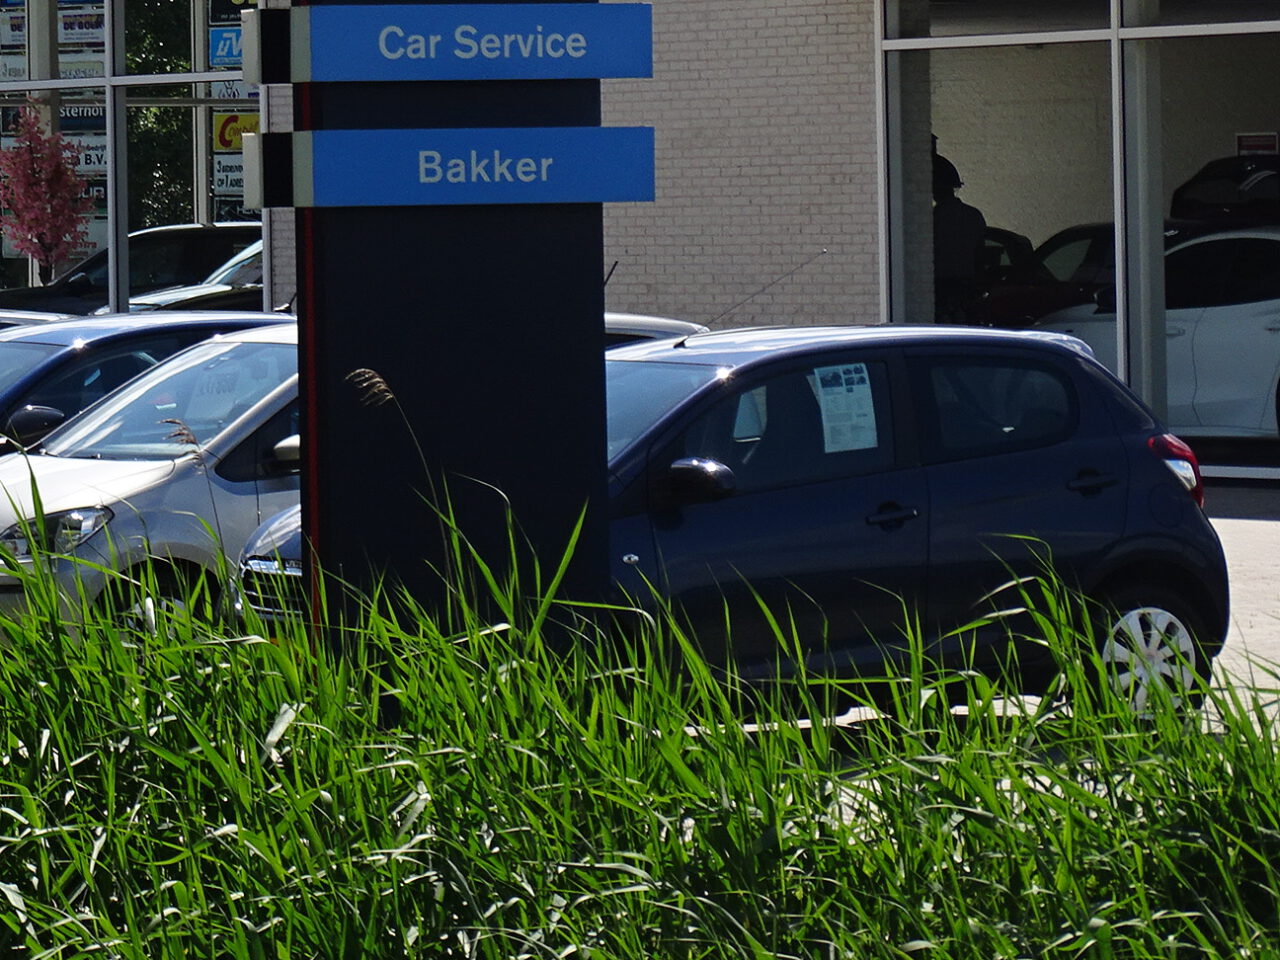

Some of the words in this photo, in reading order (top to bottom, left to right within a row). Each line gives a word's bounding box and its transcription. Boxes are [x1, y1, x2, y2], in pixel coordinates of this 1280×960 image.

[378, 25, 441, 60] Car
[453, 24, 588, 59] Service
[84, 153, 108, 166] B.V.
[418, 149, 554, 184] Bakker
